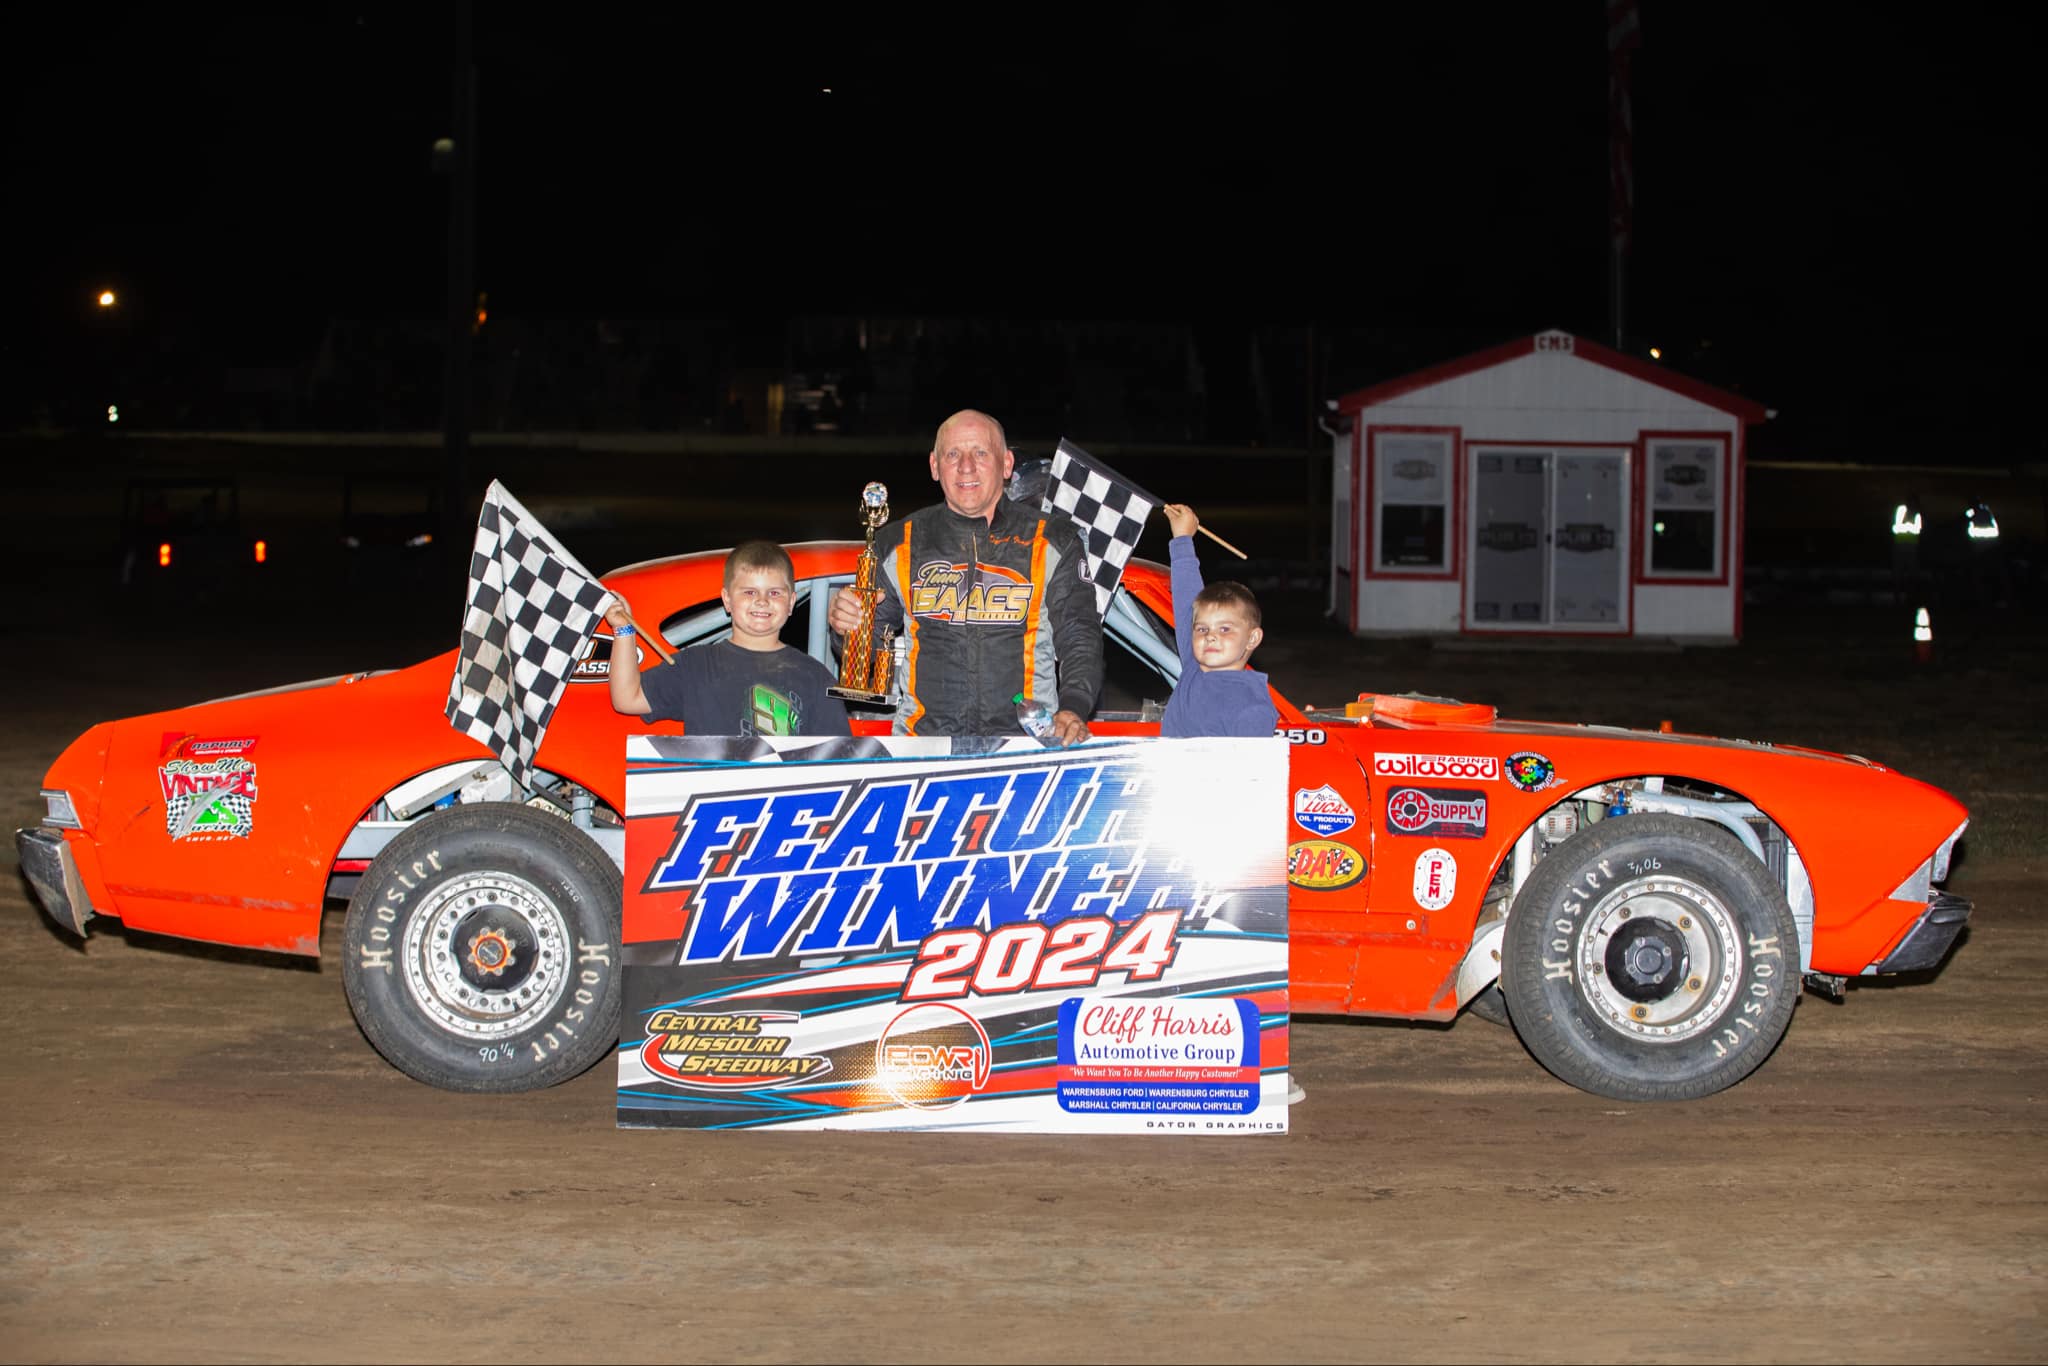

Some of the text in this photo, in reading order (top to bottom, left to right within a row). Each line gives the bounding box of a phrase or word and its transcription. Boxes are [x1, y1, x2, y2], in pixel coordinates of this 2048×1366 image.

[1538, 336, 1571, 351] CMS
[919, 563, 962, 587] Team
[1375, 756, 1497, 778] wilwood
[1438, 756, 1490, 764] RACING
[159, 767, 257, 801] VINTAGE
[1391, 791, 1429, 809] ROD
[1313, 816, 1352, 824] PRODUCTS
[1431, 804, 1484, 820] SUPPLY
[654, 764, 1155, 884] FEATUR
[1294, 848, 1345, 879] DAY
[361, 850, 442, 974] Hoosier
[1542, 859, 1614, 984] Hoosier
[903, 911, 1181, 1000] 2024
[531, 938, 610, 1062] Hoosier
[1713, 933, 1782, 1058] Hoosier
[650, 1013, 759, 1031] CENTRAL
[1082, 1005, 1235, 1043] Cliff Harris
[662, 1034, 788, 1053] MISSOURI
[1080, 1044, 1235, 1064] Automotive Group
[682, 1056, 820, 1074] SPEEDWAY
[1086, 1068, 1106, 1077] Want
[1107, 1068, 1122, 1077] You
[1123, 1069, 1132, 1078] To
[1133, 1069, 1144, 1078] Be
[1144, 1069, 1174, 1078] Another
[1175, 1069, 1200, 1080] Happy
[1063, 1088, 1249, 1098] WARRENSBURG FORD WARRENSBURG CHRYSLER
[1069, 1101, 1243, 1110] MARSHALL CHRYSLER CALIFORNIA CHRYSLER
